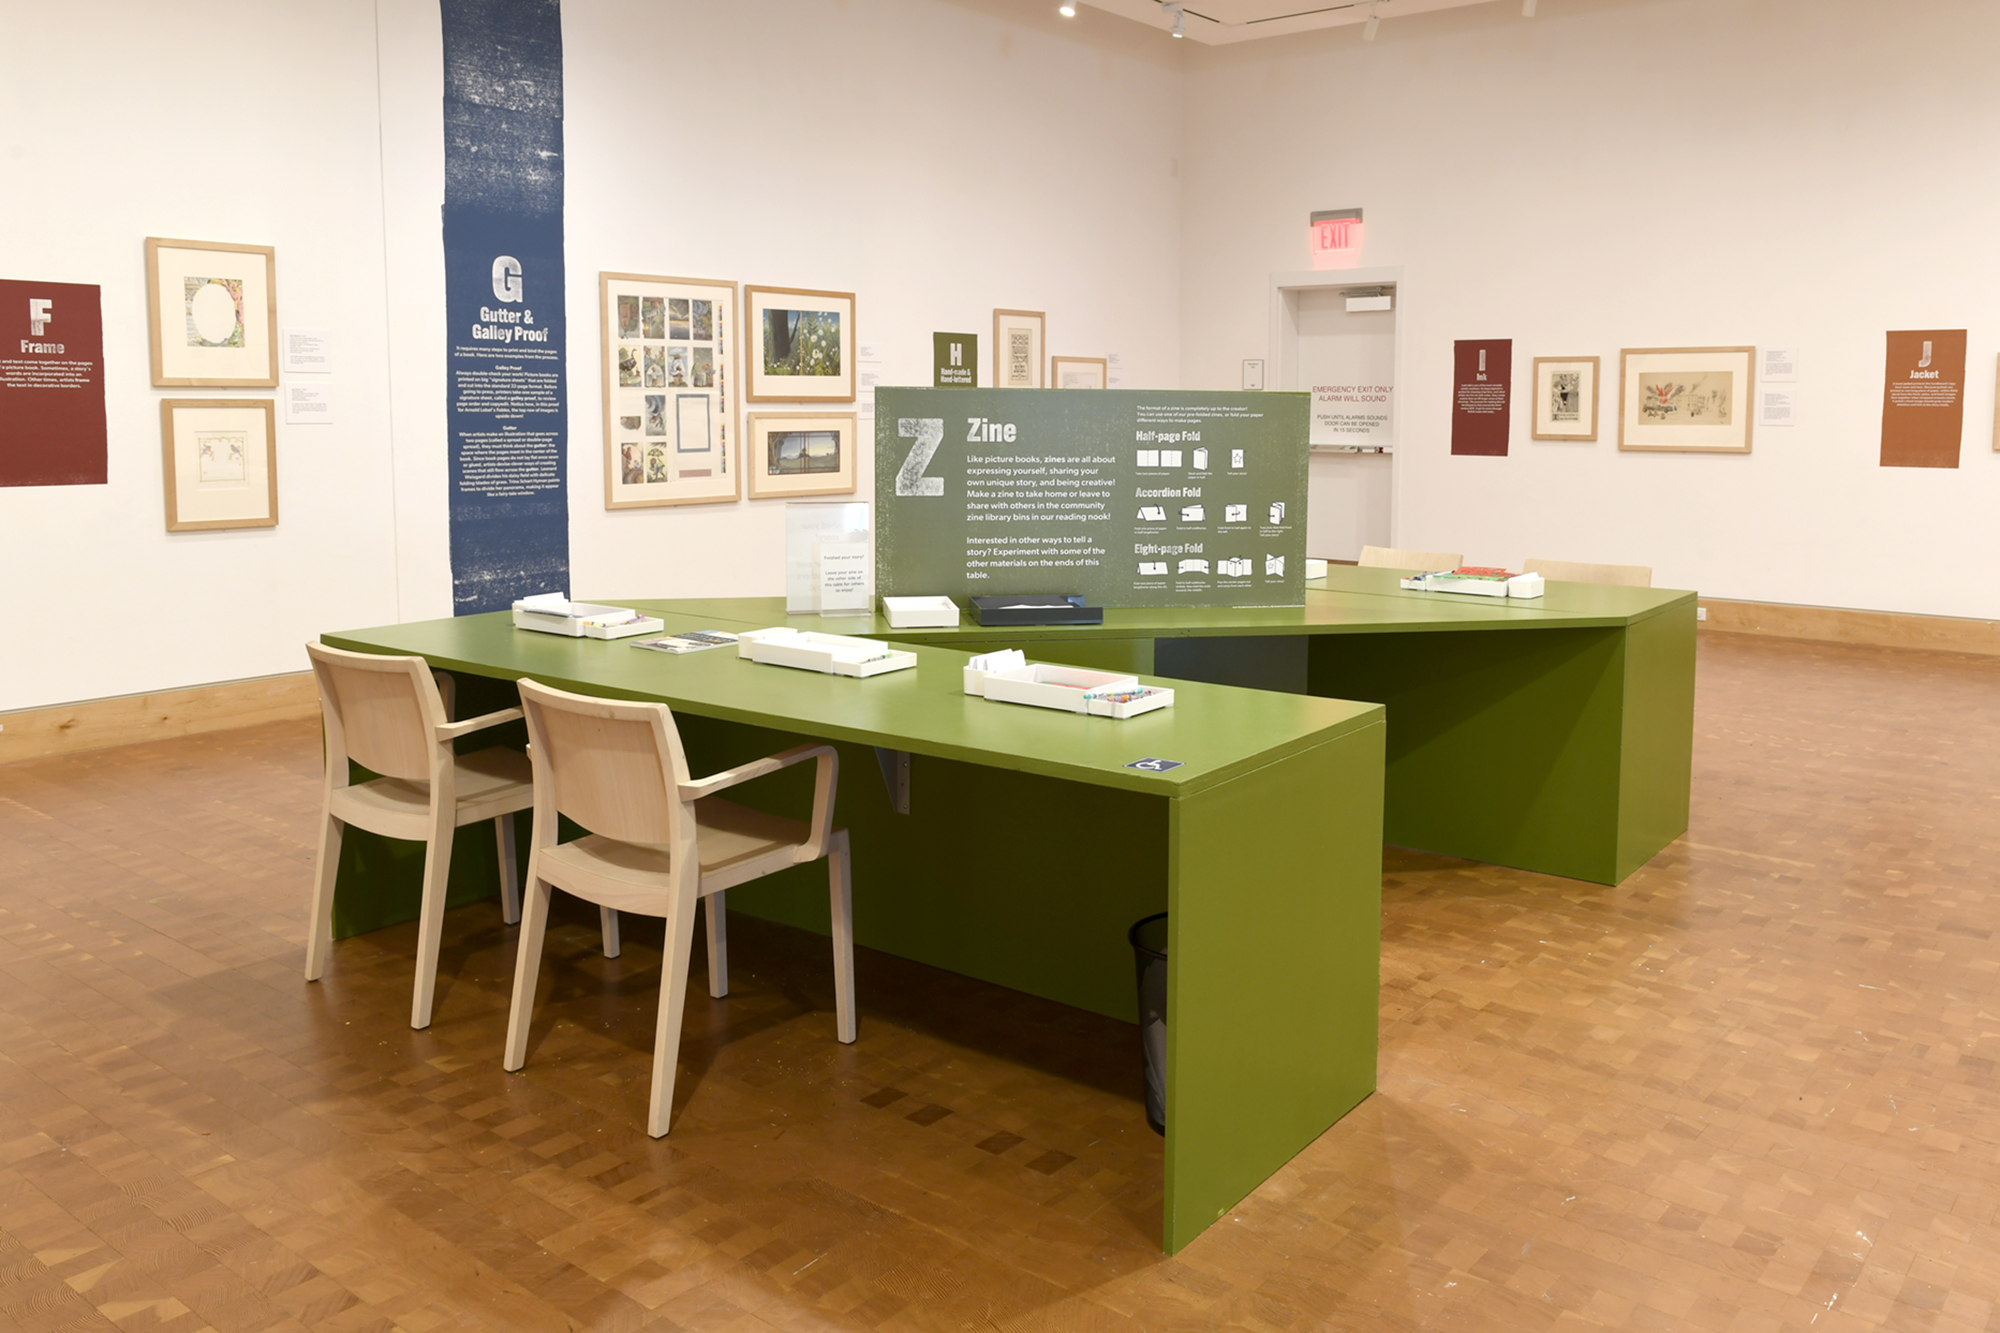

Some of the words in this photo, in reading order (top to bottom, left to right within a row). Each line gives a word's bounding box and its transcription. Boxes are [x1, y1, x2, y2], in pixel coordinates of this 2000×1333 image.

[1321, 224, 1350, 250] EXIT
[492, 255, 523, 303] G
[29, 298, 52, 336] F
[480, 306, 521, 323] Gutter
[524, 310, 534, 324] &
[472, 324, 512, 343] Galley
[515, 326, 548, 342] Proof
[21, 340, 65, 354] Frame
[950, 343, 962, 366] H
[1918, 341, 1932, 367] J
[1910, 370, 1939, 379] Jacket
[967, 418, 1017, 442] Zine
[1136, 431, 1180, 443] Half-page
[1182, 431, 1200, 441] Fold
[895, 418, 944, 496] Z
[985, 455, 1013, 464] picture
[1015, 455, 1042, 464] books,
[967, 468, 1011, 476] expressing
[1013, 467, 1047, 476] yourself,
[1050, 467, 1079, 476] sharing
[986, 479, 1014, 488] unique
[1016, 479, 1038, 487] story,
[1057, 478, 1080, 487] being
[1135, 487, 1181, 498] Accordion
[1183, 487, 1201, 498] Fold
[1061, 502, 1105, 510] community
[985, 514, 1011, 522] library
[1056, 513, 1086, 522] reading
[967, 548, 991, 557] story?
[994, 548, 1039, 556] Experiment
[1134, 544, 1183, 555] Eight-page
[1185, 543, 1203, 553] Fold
